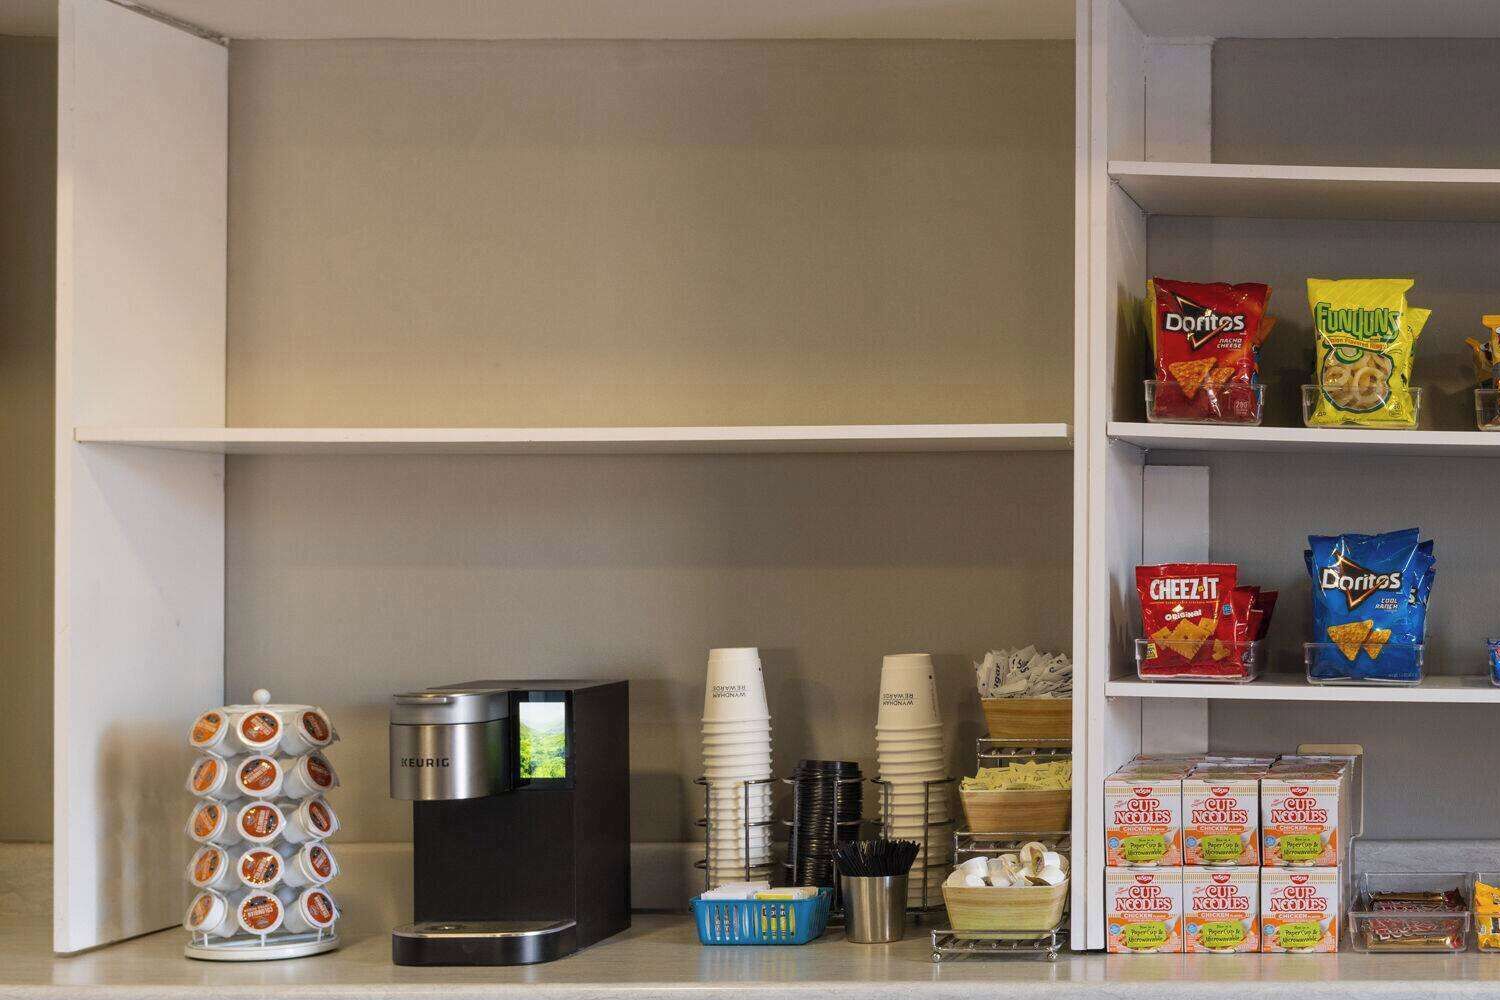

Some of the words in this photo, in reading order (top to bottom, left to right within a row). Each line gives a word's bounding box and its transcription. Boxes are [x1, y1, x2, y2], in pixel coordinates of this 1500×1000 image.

[1165, 313, 1245, 333] Doritos
[1321, 568, 1401, 591] Doritos
[401, 757, 450, 768] KEURIG
[1127, 798, 1160, 811] CUP
[1205, 797, 1236, 811] CUP
[1284, 797, 1316, 810] CUP
[1114, 810, 1171, 824] NOODLES
[1191, 809, 1248, 823] NOODLES
[1271, 809, 1327, 823] NOODLES
[1129, 885, 1161, 899] CUP
[1205, 885, 1238, 898] CUP
[1284, 886, 1316, 898] CUP
[1116, 897, 1172, 911] NOODLES
[1192, 896, 1249, 910] NOODLES
[1270, 897, 1327, 911] NOODLES
